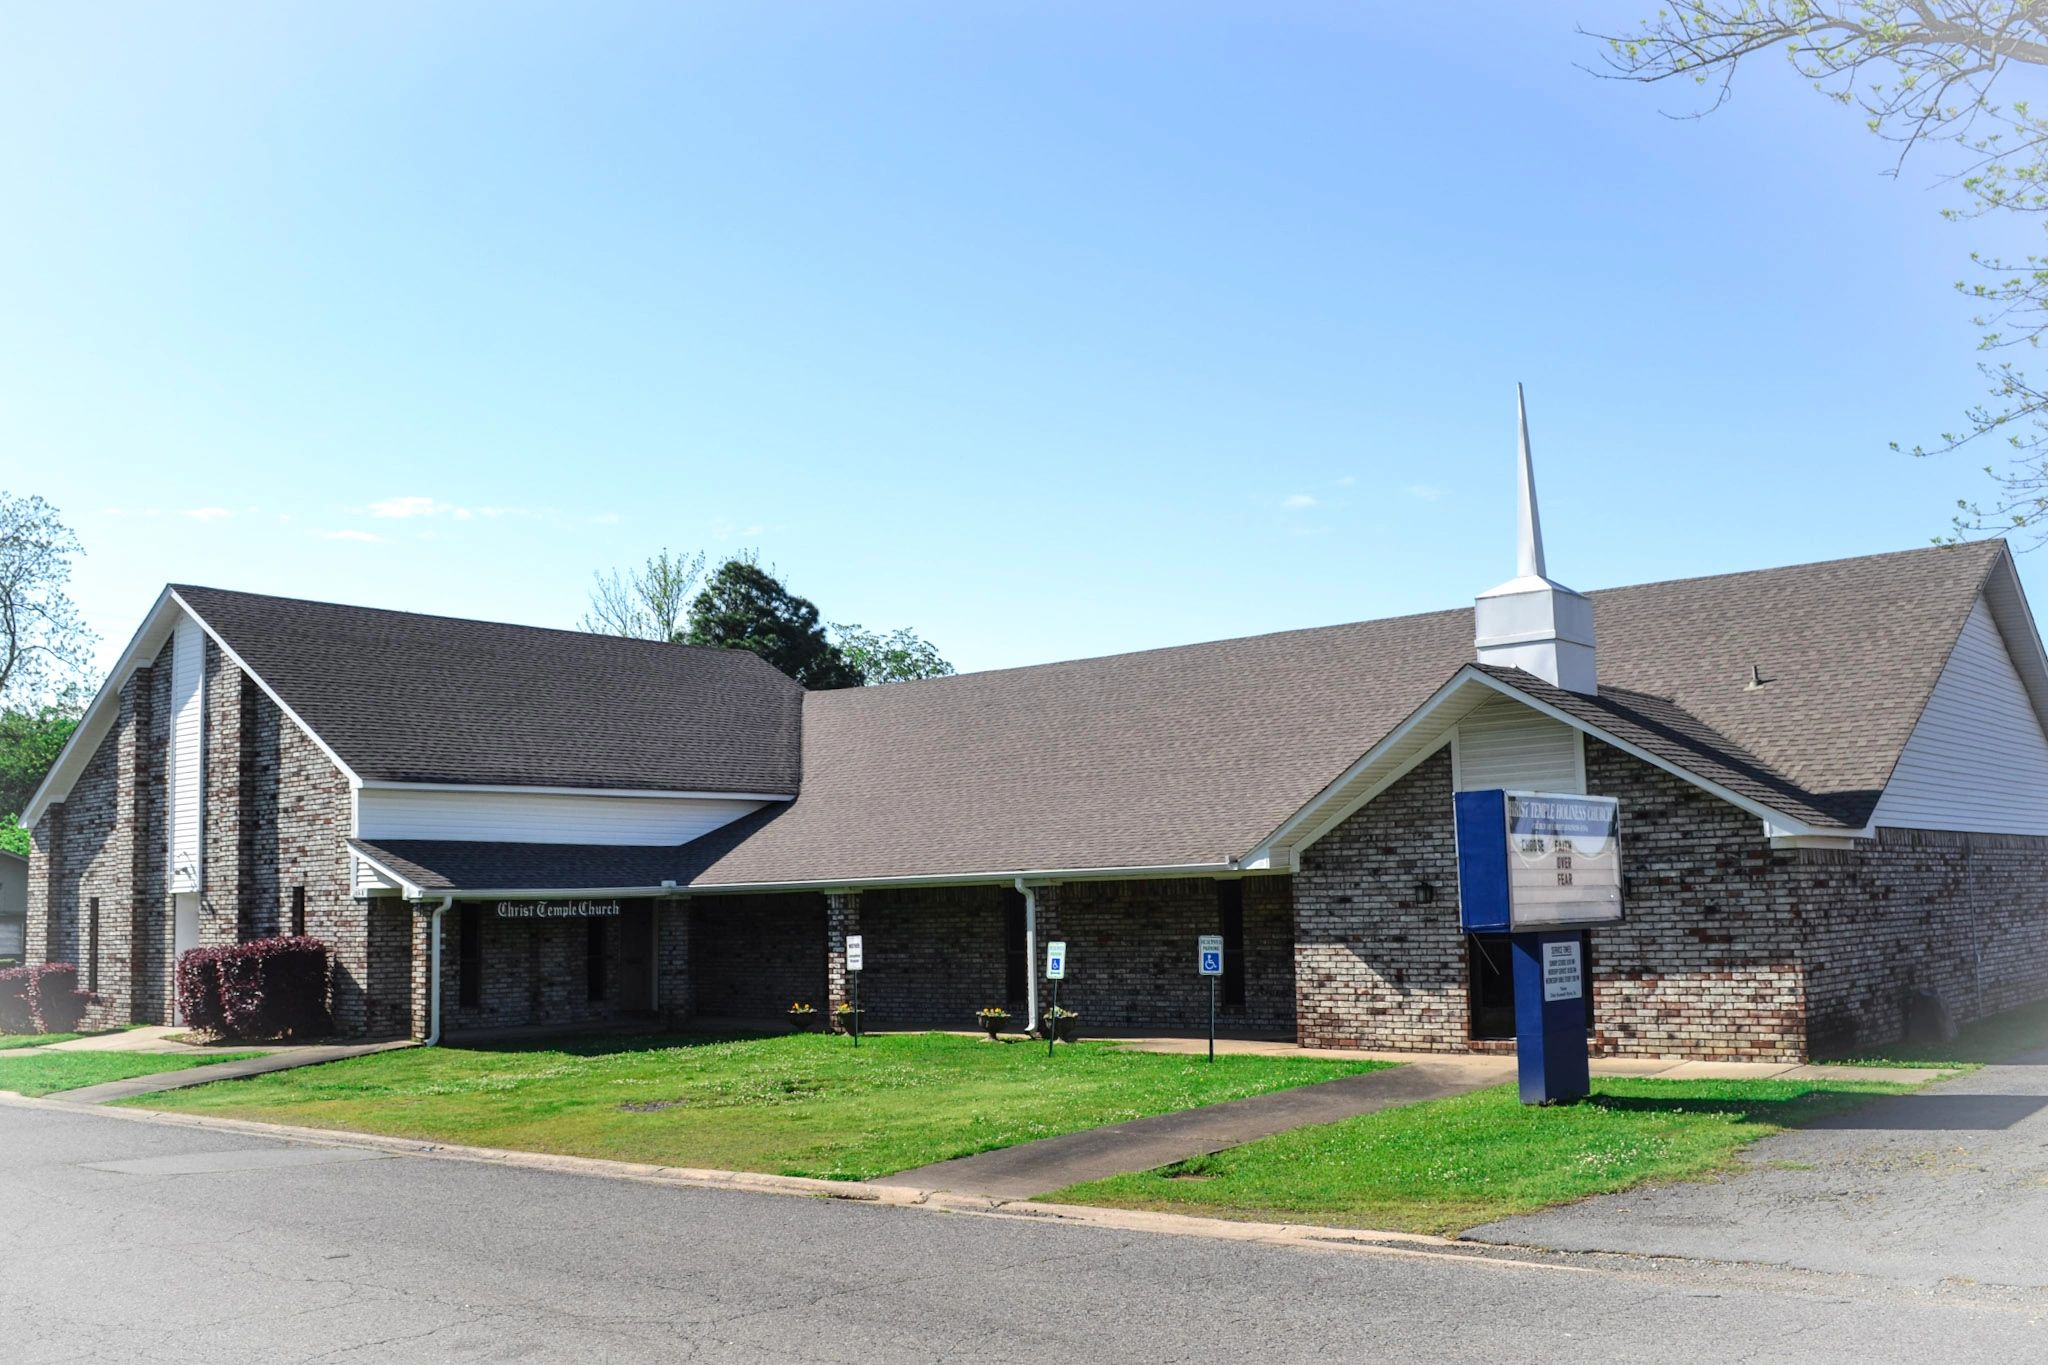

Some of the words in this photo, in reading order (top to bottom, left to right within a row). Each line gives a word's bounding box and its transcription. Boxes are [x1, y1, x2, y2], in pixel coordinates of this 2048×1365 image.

[1587, 805, 1613, 822] CHURCH
[1557, 857, 1572, 869] OVER
[1557, 873, 1573, 886] FEAR
[497, 901, 534, 918] Christ
[537, 900, 577, 918] Temple
[578, 900, 619, 916] Church
